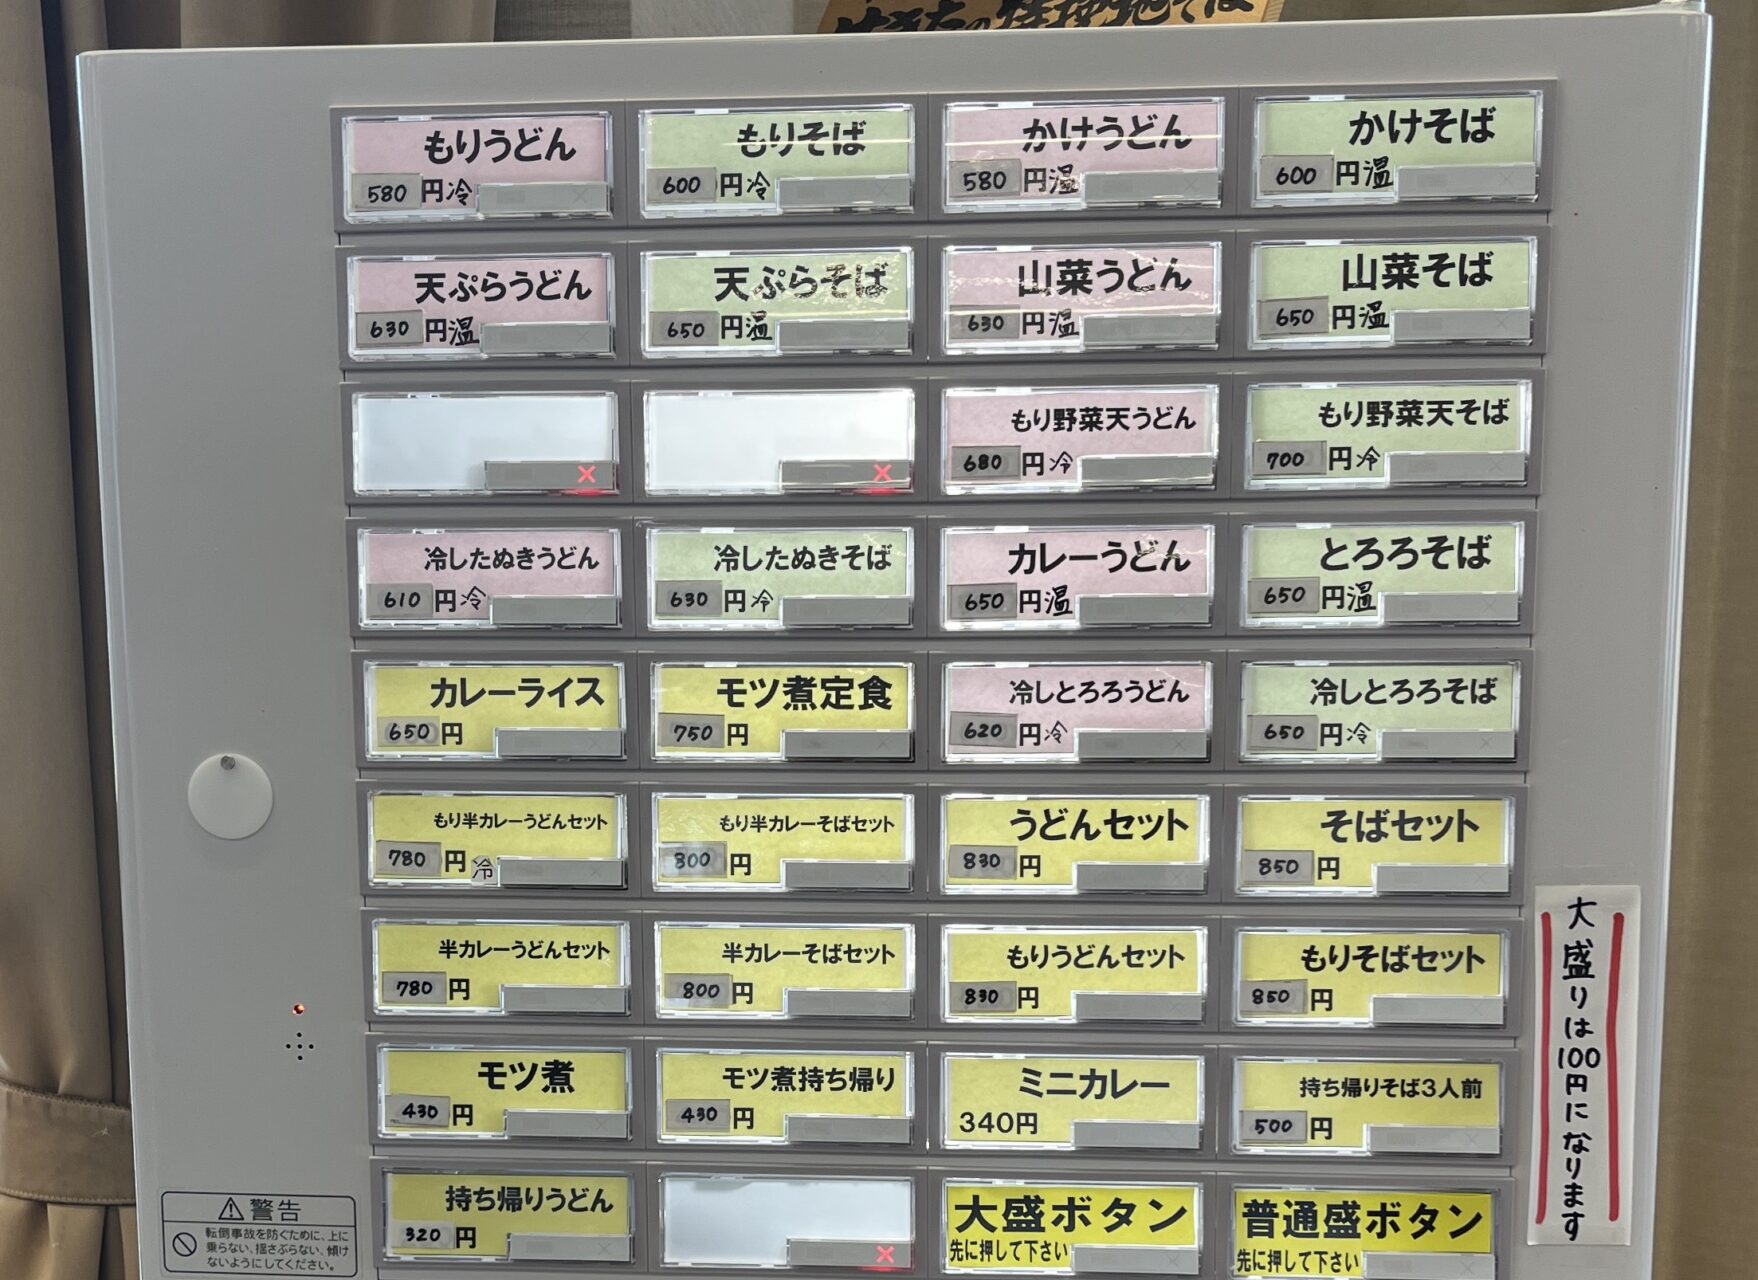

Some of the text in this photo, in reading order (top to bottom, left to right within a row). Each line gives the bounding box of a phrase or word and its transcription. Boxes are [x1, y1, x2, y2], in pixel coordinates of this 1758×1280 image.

[737, 121, 867, 158] もりそば
[1022, 114, 1192, 153] かけうどん
[1349, 107, 1496, 146] かけそば
[424, 127, 576, 163] もりうどん
[714, 262, 888, 301] 天ぷらそば
[1018, 253, 1192, 297] 山菜うどん
[1342, 250, 1494, 291] 山菜そば
[414, 270, 592, 303] 天ぷらうどん
[1011, 406, 1197, 432] もり野菜天うどん
[1318, 398, 1510, 428] もり野菜天そば
[424, 546, 600, 571] 冷したぬきうどん
[713, 543, 893, 572] 冷したぬきそば
[1008, 538, 1192, 575] カレーうどん
[1320, 534, 1492, 571] とろろそば
[430, 677, 605, 708] カレーライス
[716, 675, 893, 711] モツ煮定食
[1009, 679, 1190, 705] 冷しとろろうどん
[1310, 676, 1498, 706] 冷しとろろそば
[433, 812, 609, 831] もり半カレーうどんセット
[719, 815, 896, 834] もり半カレーそばセット
[1010, 808, 1190, 842] うどんセット
[1320, 808, 1480, 844] そばセット
[438, 939, 611, 961] 半カレーうどんセット
[722, 943, 896, 965] 半カレーそばセット
[1007, 944, 1186, 970] もりうどんセット
[1301, 944, 1486, 974] もりそばセット
[477, 1060, 575, 1094] モツ煮
[722, 1067, 896, 1092] モツ煮持ち帰り
[1018, 1067, 1170, 1101] ミニカレー
[1557, 896, 1601, 1241] 大盛りは100円になります
[959, 1111, 1039, 1135] 340円
[250, 1198, 301, 1222] 警告
[446, 1185, 614, 1213] 持ち帰りうどん
[954, 1194, 1188, 1234] 大盛ボタン
[1241, 1200, 1484, 1240] 普通盛ボタン
[950, 1239, 1069, 1264] 先に押して下さい
[1236, 1249, 1360, 1275] 先に押して下さい
